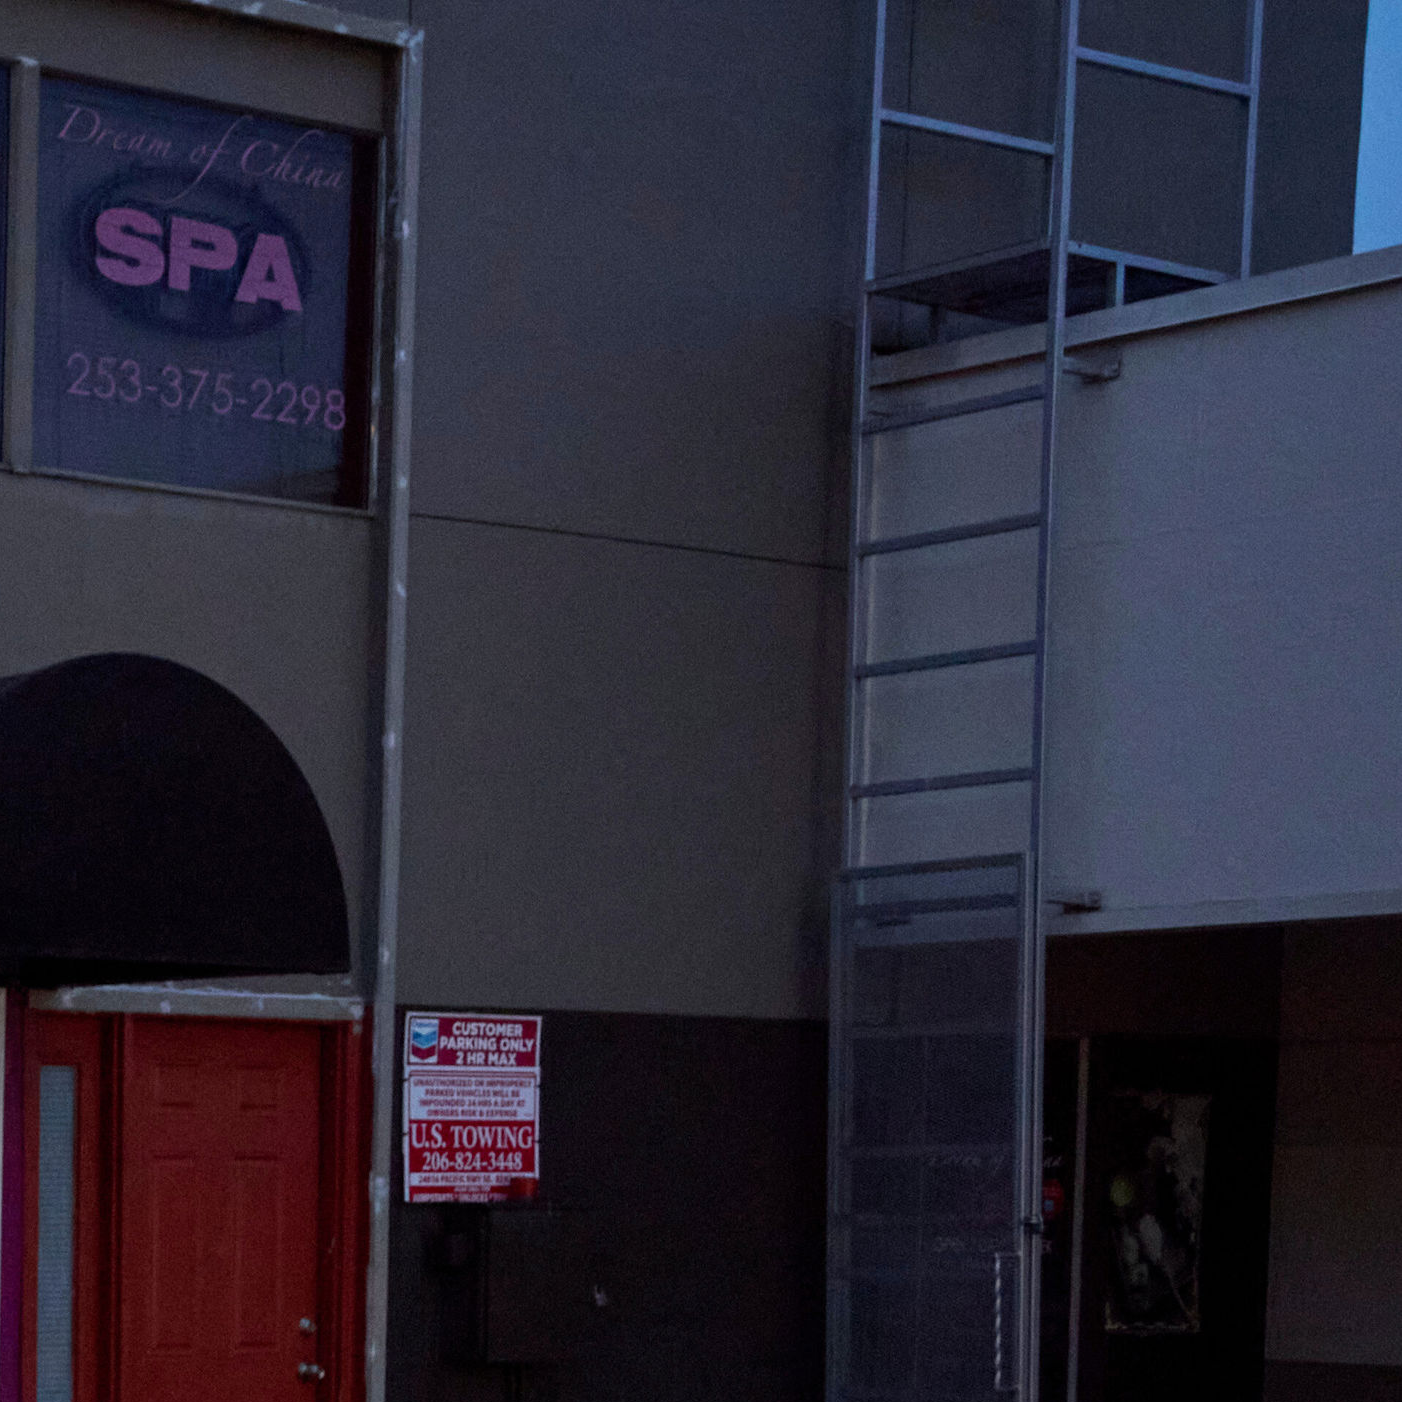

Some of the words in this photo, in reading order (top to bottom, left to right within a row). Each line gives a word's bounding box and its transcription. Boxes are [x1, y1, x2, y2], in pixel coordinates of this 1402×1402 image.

[59, 103, 173, 158] Dream
[154, 114, 253, 204] of
[240, 128, 344, 188] China
[95, 206, 303, 311] SPA
[66, 352, 346, 430] 253-375-2298
[452, 1021, 523, 1038] CUSTOMER
[440, 1035, 497, 1051] PARKING
[499, 1037, 534, 1053] ONLY
[456, 1051, 464, 1065] 2
[466, 1052, 485, 1065] HR
[487, 1052, 517, 1066] MAX
[410, 1122, 447, 1150] U.S.
[449, 1125, 533, 1150] TOWING
[421, 1151, 524, 1171] 206-824-3448
